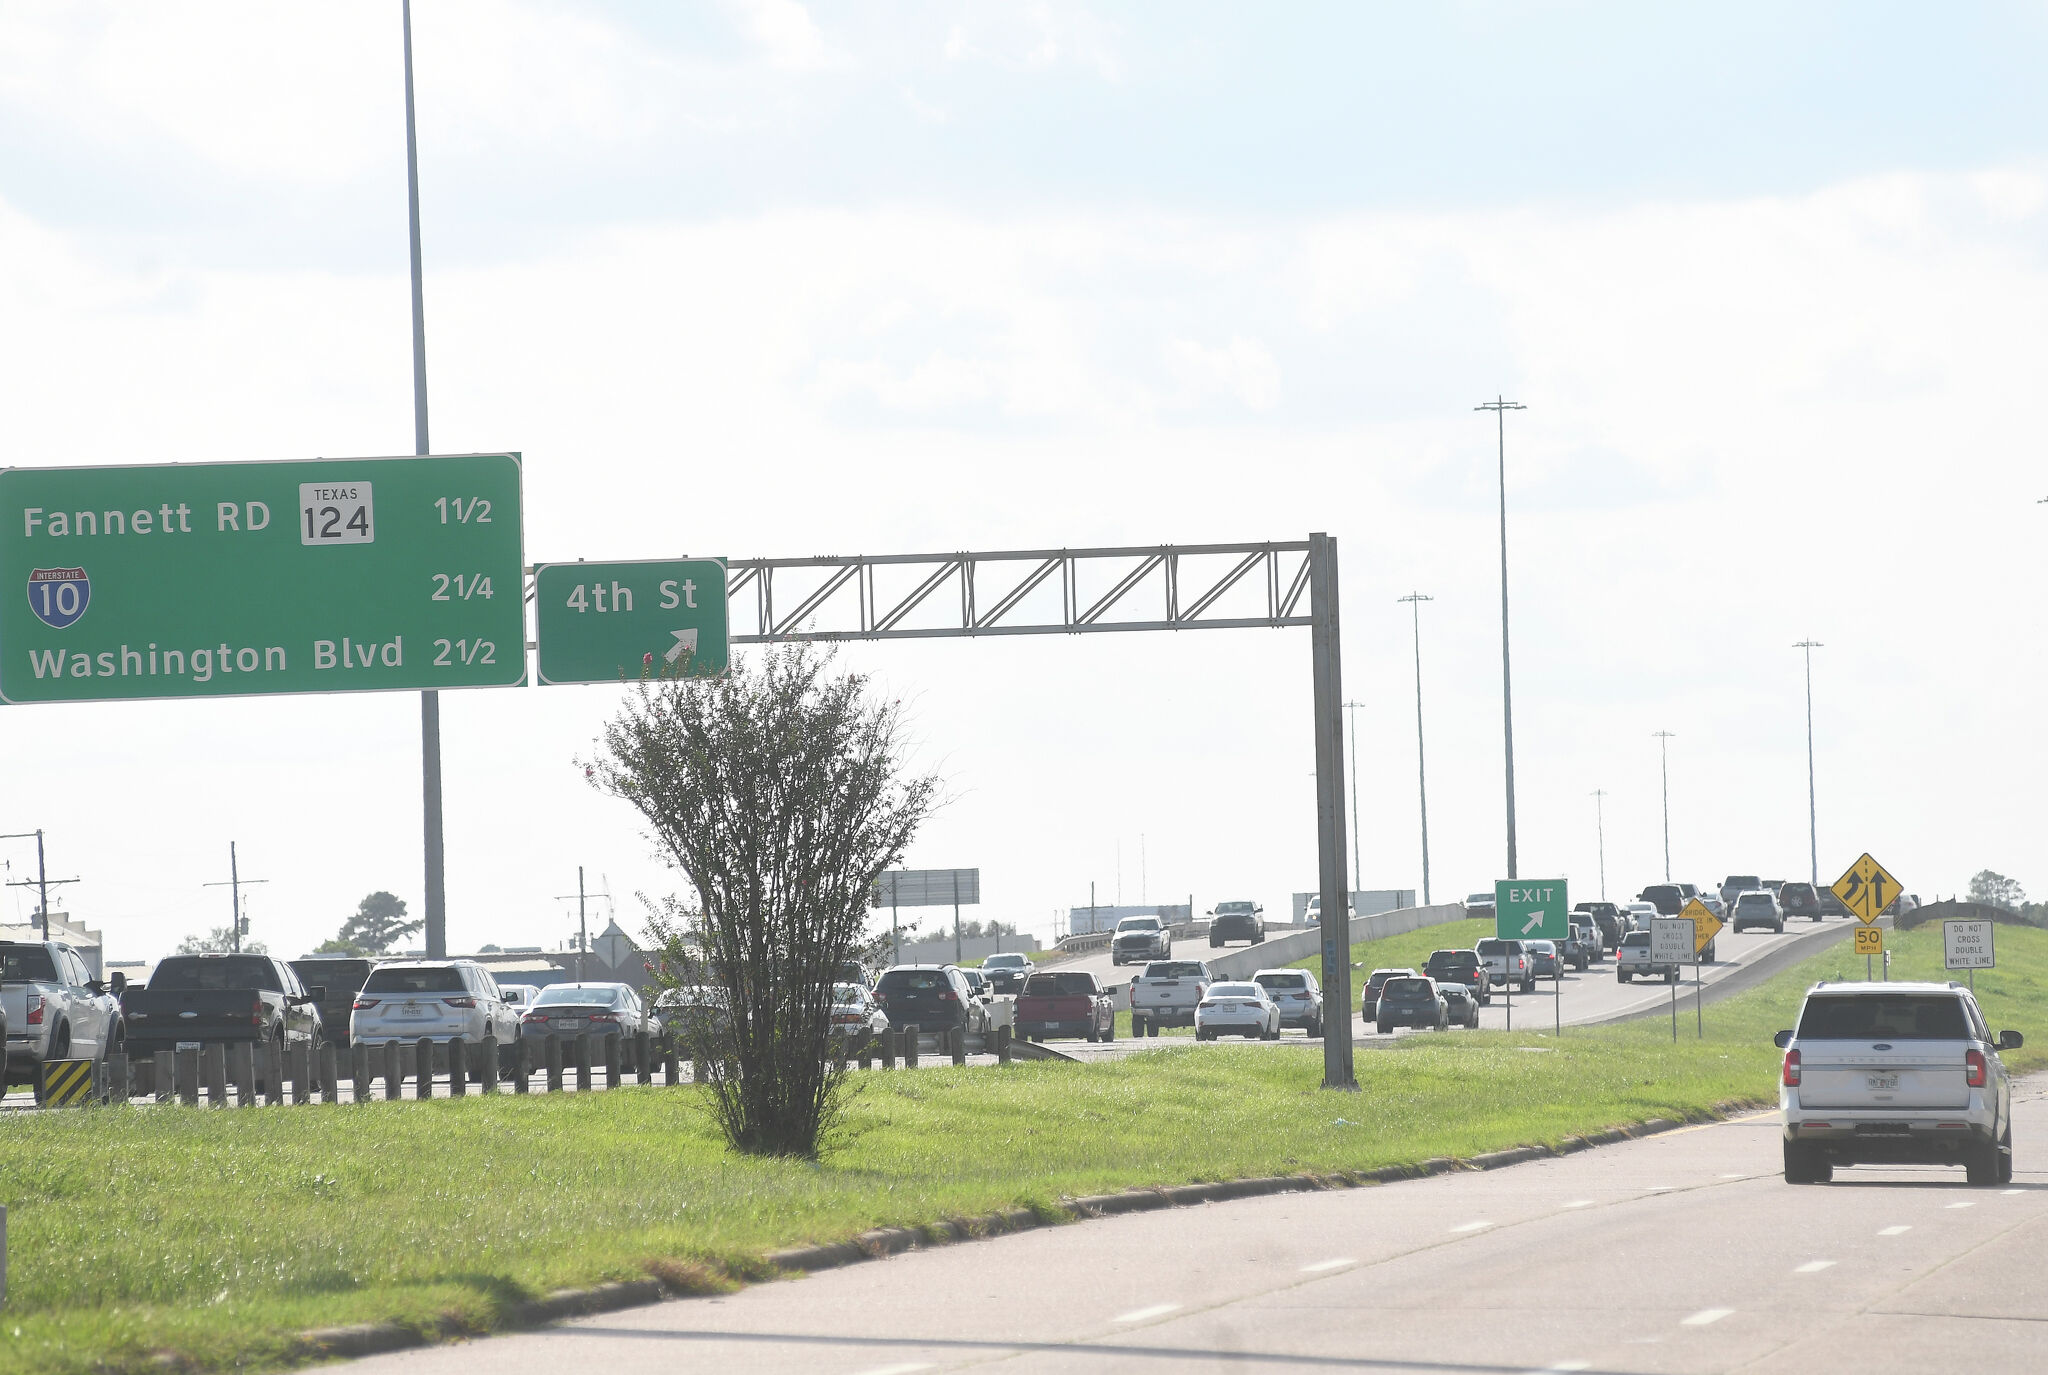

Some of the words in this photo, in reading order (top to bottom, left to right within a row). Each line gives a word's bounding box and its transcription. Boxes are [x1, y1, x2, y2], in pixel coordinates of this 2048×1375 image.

[314, 488, 358, 501] TEXAS
[24, 503, 192, 537] Fannett
[217, 501, 270, 532] RD
[305, 505, 369, 538] 124
[36, 571, 80, 580] INTERSTATE
[40, 582, 80, 616] 10
[566, 581, 633, 613] 4th
[659, 579, 698, 609] St
[29, 643, 287, 682] Washington
[314, 635, 403, 669] Blvd
[1510, 888, 1553, 903] EXIT
[1660, 922, 1668, 930] DO
[1672, 922, 1685, 930] NOT
[1953, 925, 1963, 933] DO
[1969, 924, 1982, 932] NOT
[1662, 932, 1683, 940] CROSS
[1858, 930, 1880, 944] 50
[1958, 935, 1981, 944] CROSS
[1955, 946, 1984, 954] DOUBLE
[1654, 952, 1674, 960] WHITE
[1678, 952, 1692, 960] LINE
[1949, 957, 1970, 965] WHITE
[1974, 956, 1991, 965] LINE
